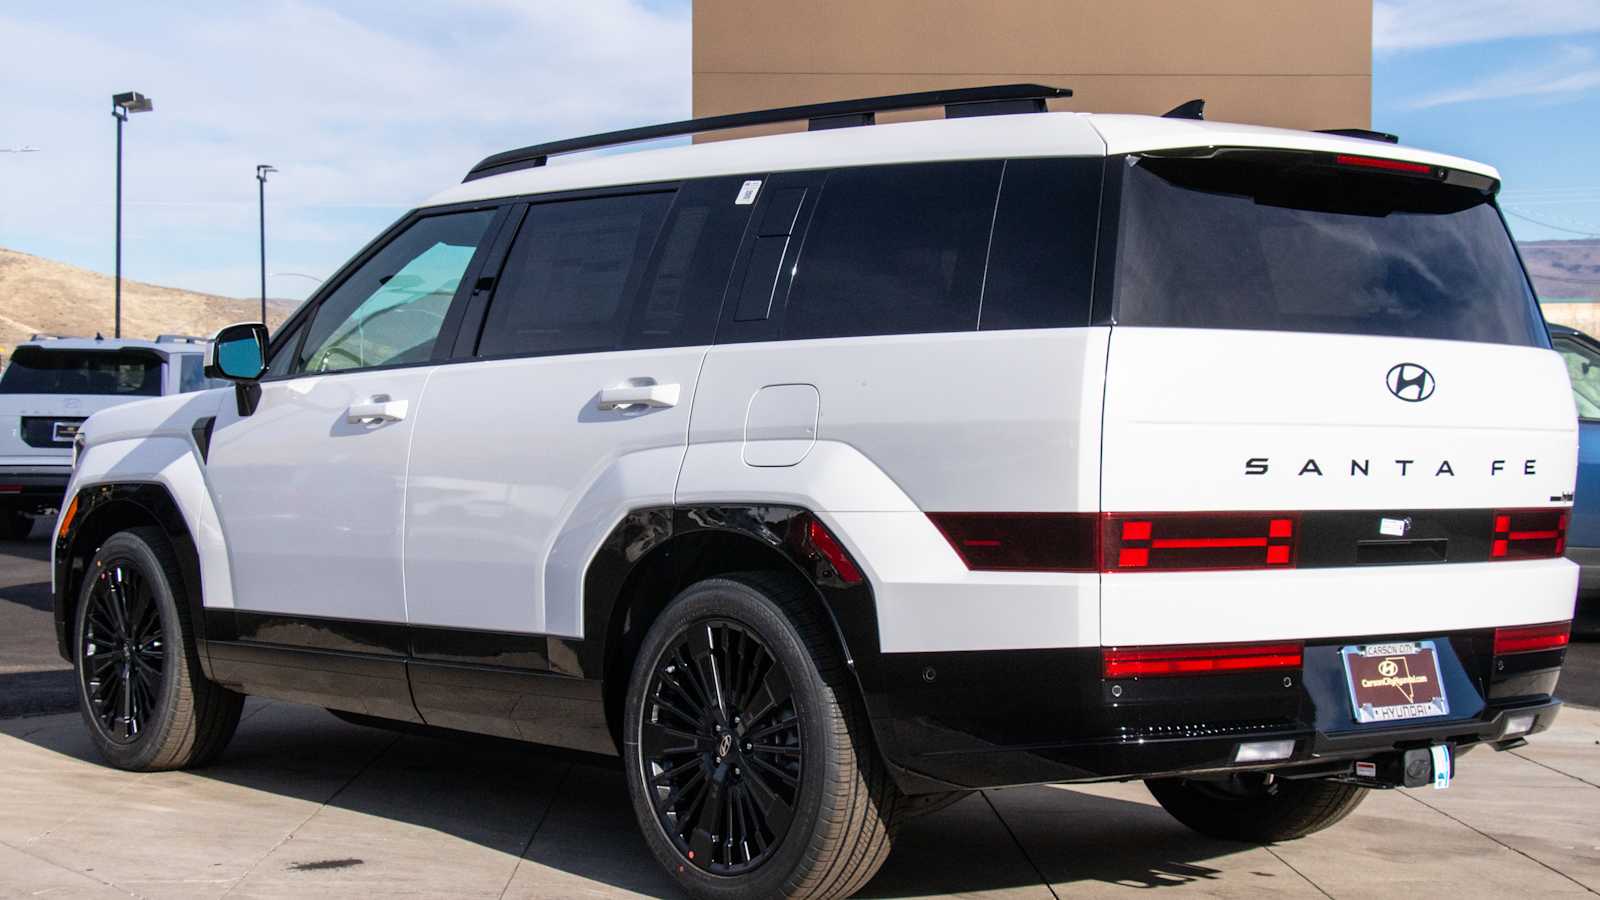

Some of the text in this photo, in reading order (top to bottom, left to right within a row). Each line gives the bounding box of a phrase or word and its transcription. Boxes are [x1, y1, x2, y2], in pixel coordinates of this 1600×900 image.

[1245, 457, 1537, 477] SANTA FE
[1368, 646, 1397, 656] CARSON
[1382, 704, 1428, 719] HYUNDAI
